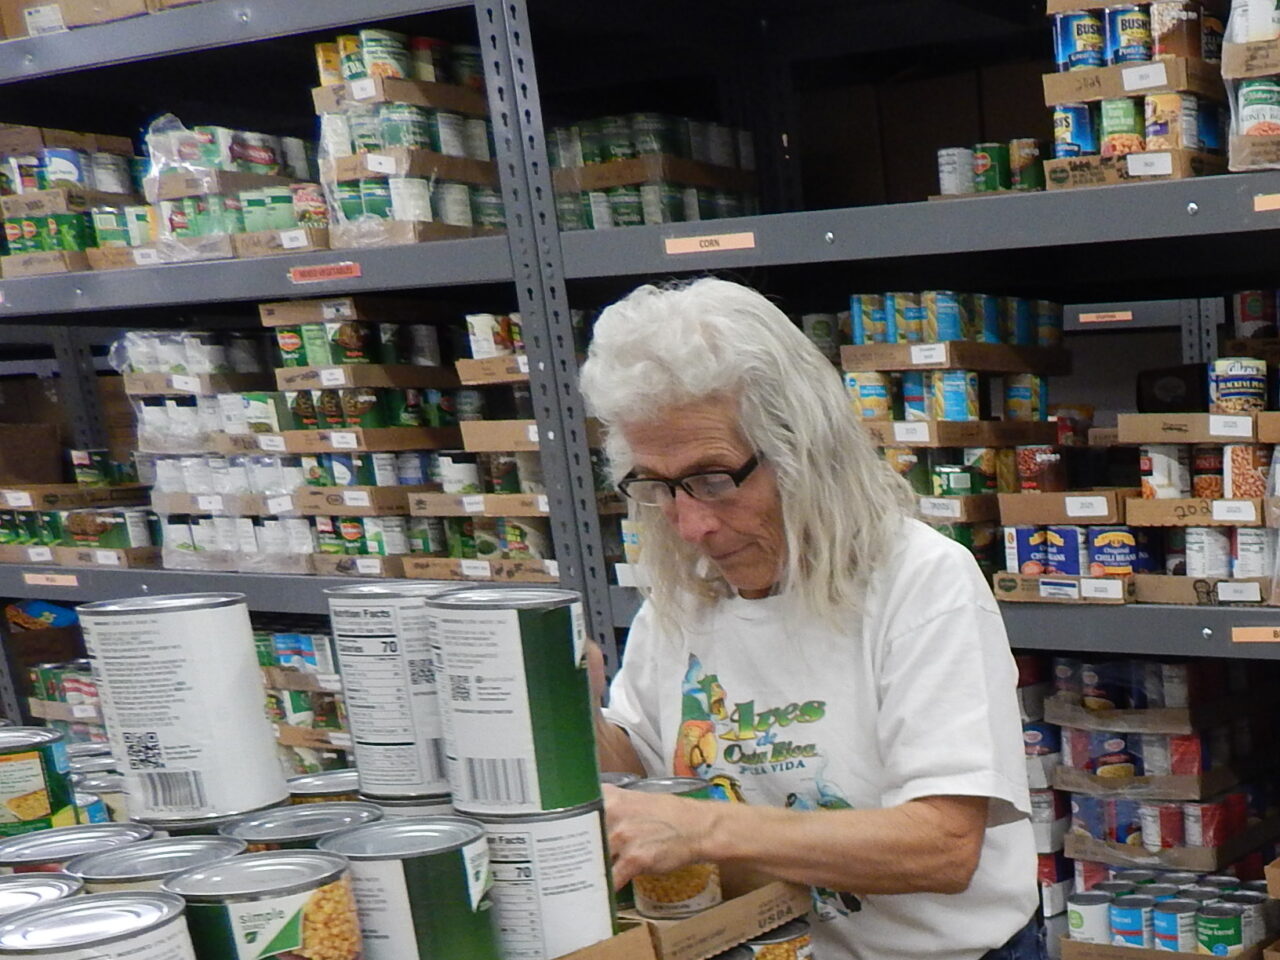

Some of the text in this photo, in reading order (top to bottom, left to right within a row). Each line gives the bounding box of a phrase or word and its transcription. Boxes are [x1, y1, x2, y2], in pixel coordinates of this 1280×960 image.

[1076, 22, 1101, 37] BUS
[1120, 17, 1150, 32] BUSH'
[698, 238, 720, 248] CORN
[1174, 500, 1212, 521] 202
[362, 608, 391, 619] Facts
[381, 640, 399, 654] 70
[769, 741, 820, 763] Rica
[769, 759, 806, 773] VIDA
[498, 834, 527, 846] Facts
[516, 866, 531, 878] 70
[757, 905, 794, 930] USDA
